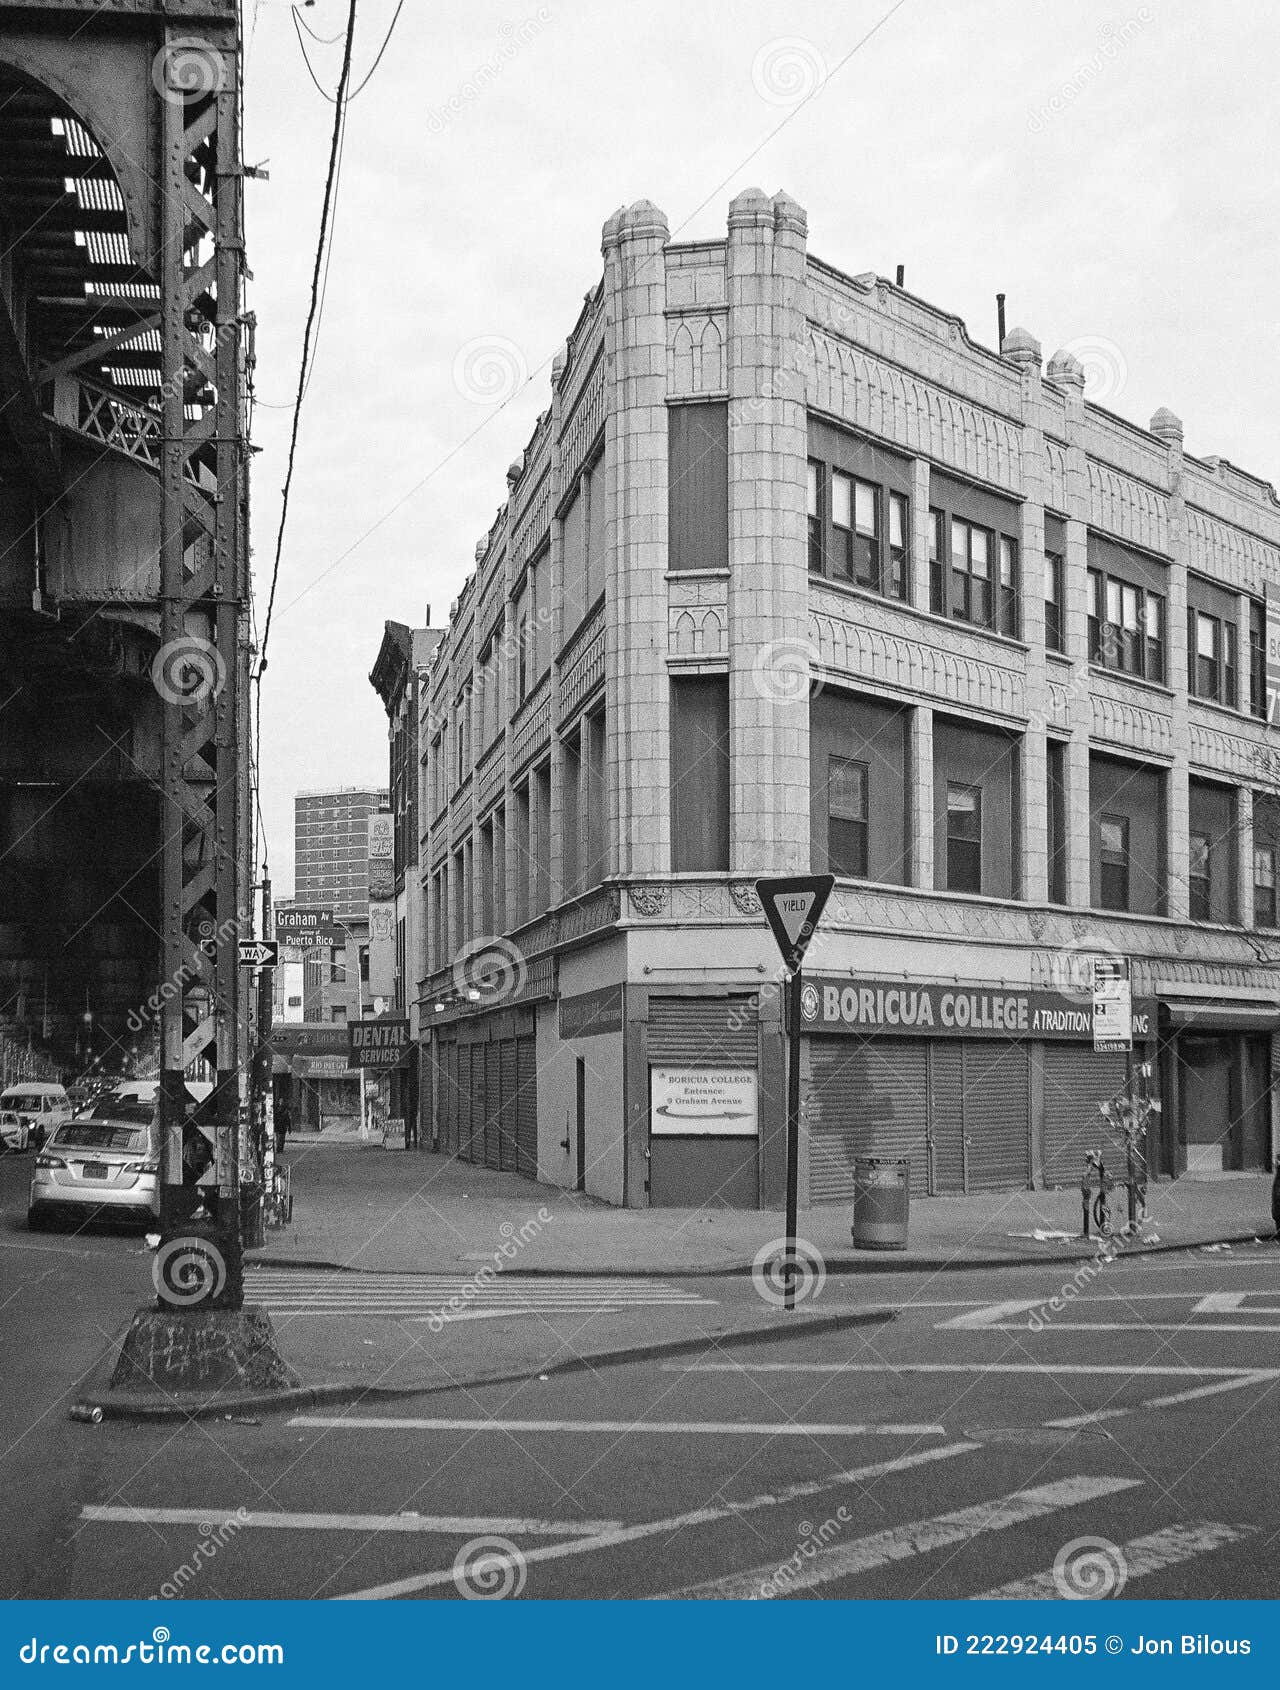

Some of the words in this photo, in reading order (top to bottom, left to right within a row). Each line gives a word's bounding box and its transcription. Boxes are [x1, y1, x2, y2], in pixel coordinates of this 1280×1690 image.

[783, 899, 806, 912] YIELD
[278, 911, 317, 926] Graham
[286, 935, 313, 945] Puerto
[316, 935, 334, 945] Rico
[244, 949, 266, 959] WAY
[823, 985, 934, 1026] BORICUA
[940, 993, 1028, 1030] COLLEGE
[1032, 1010, 1040, 1030] A
[1041, 1010, 1091, 1032] TRADITION
[353, 1026, 407, 1047] DENTAL
[360, 1049, 400, 1063] SERVICES
[668, 1076, 708, 1084] BORICUA
[711, 1076, 753, 1084] COLLEGE
[675, 1097, 708, 1105] Graham
[711, 1097, 742, 1105] Avenue
